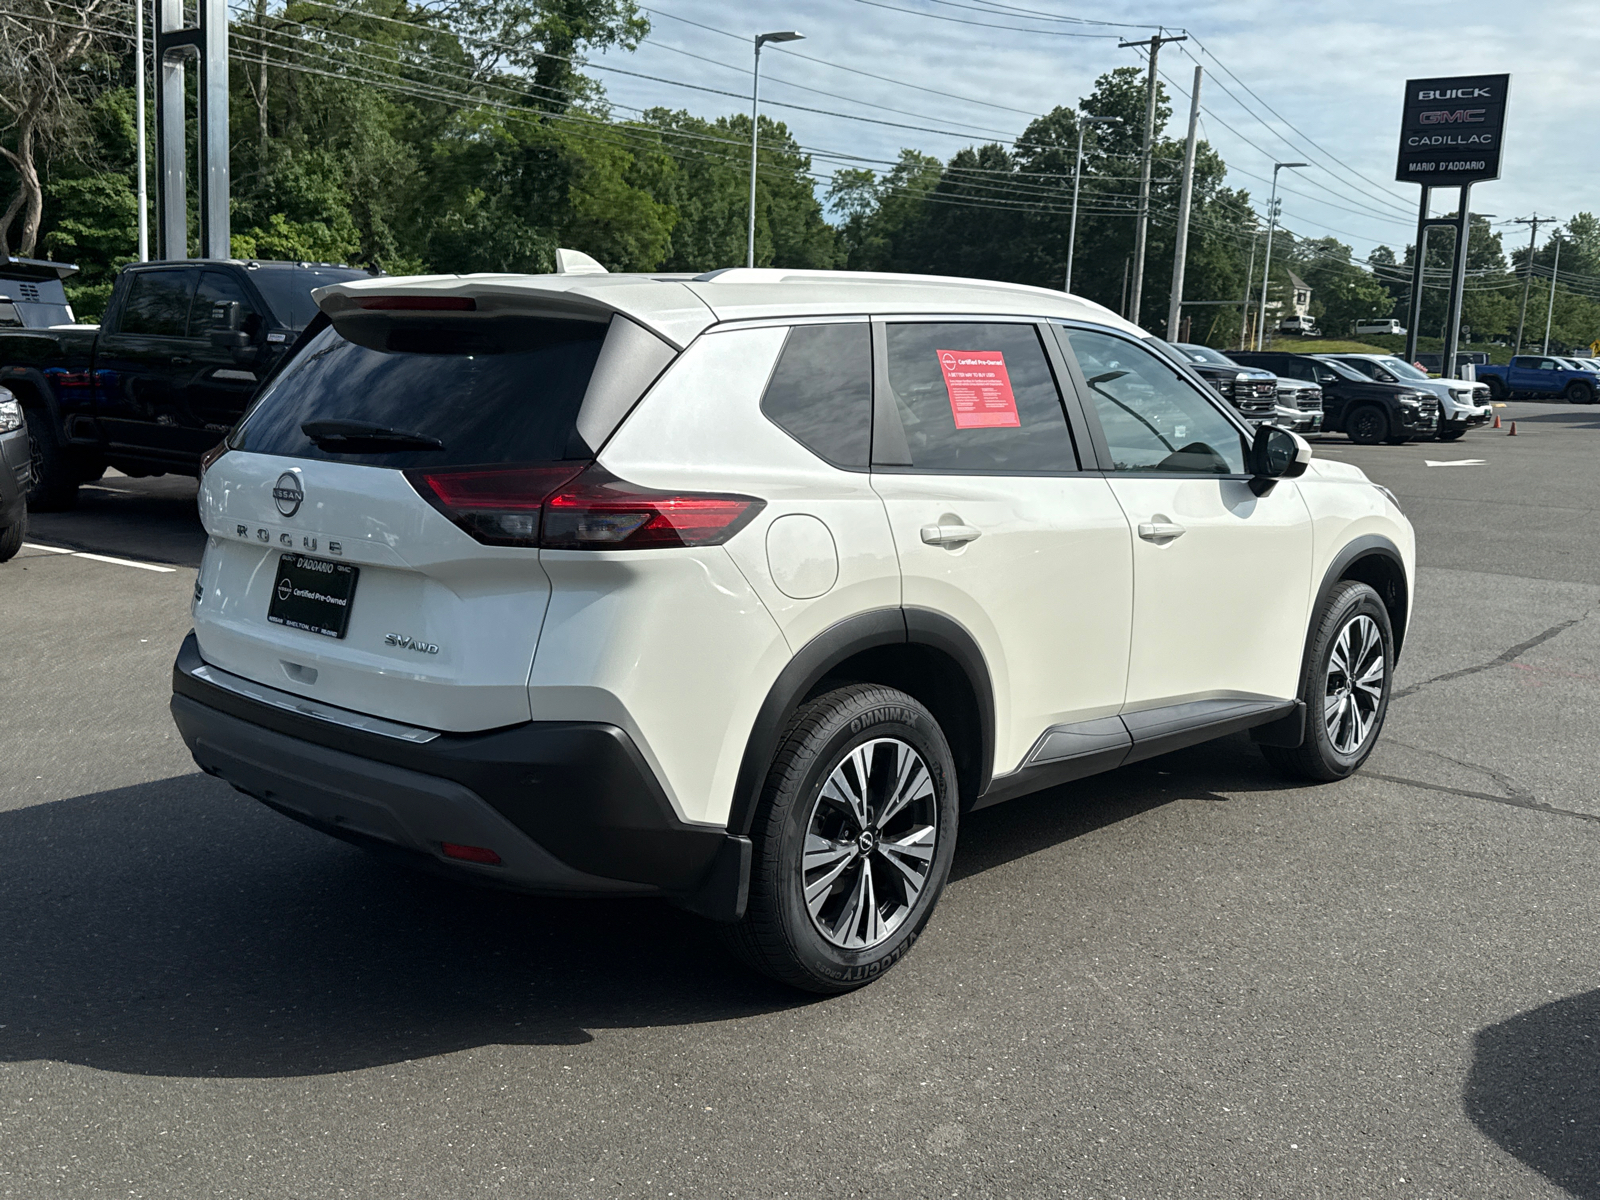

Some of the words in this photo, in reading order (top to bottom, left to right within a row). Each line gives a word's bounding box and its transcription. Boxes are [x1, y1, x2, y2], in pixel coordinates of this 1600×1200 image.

[1418, 88, 1491, 100] BUICK
[1420, 109, 1486, 124] GMC
[1408, 134, 1492, 146] CADILLAC
[1408, 162, 1436, 172] MARIO
[1439, 161, 1486, 171] D'ADDARIO
[273, 488, 303, 500] NISSAN
[236, 524, 343, 556] ROGUE
[297, 558, 334, 573] D'ADDARIO
[337, 565, 352, 573] GMC
[293, 588, 315, 599] Certified
[314, 592, 347, 606] Pre-Owned
[385, 632, 412, 649] SV
[408, 640, 439, 655] AWD
[850, 706, 919, 734] OMNIMAX
[842, 931, 918, 981] VELOCITY
[814, 961, 842, 979] CROSS
